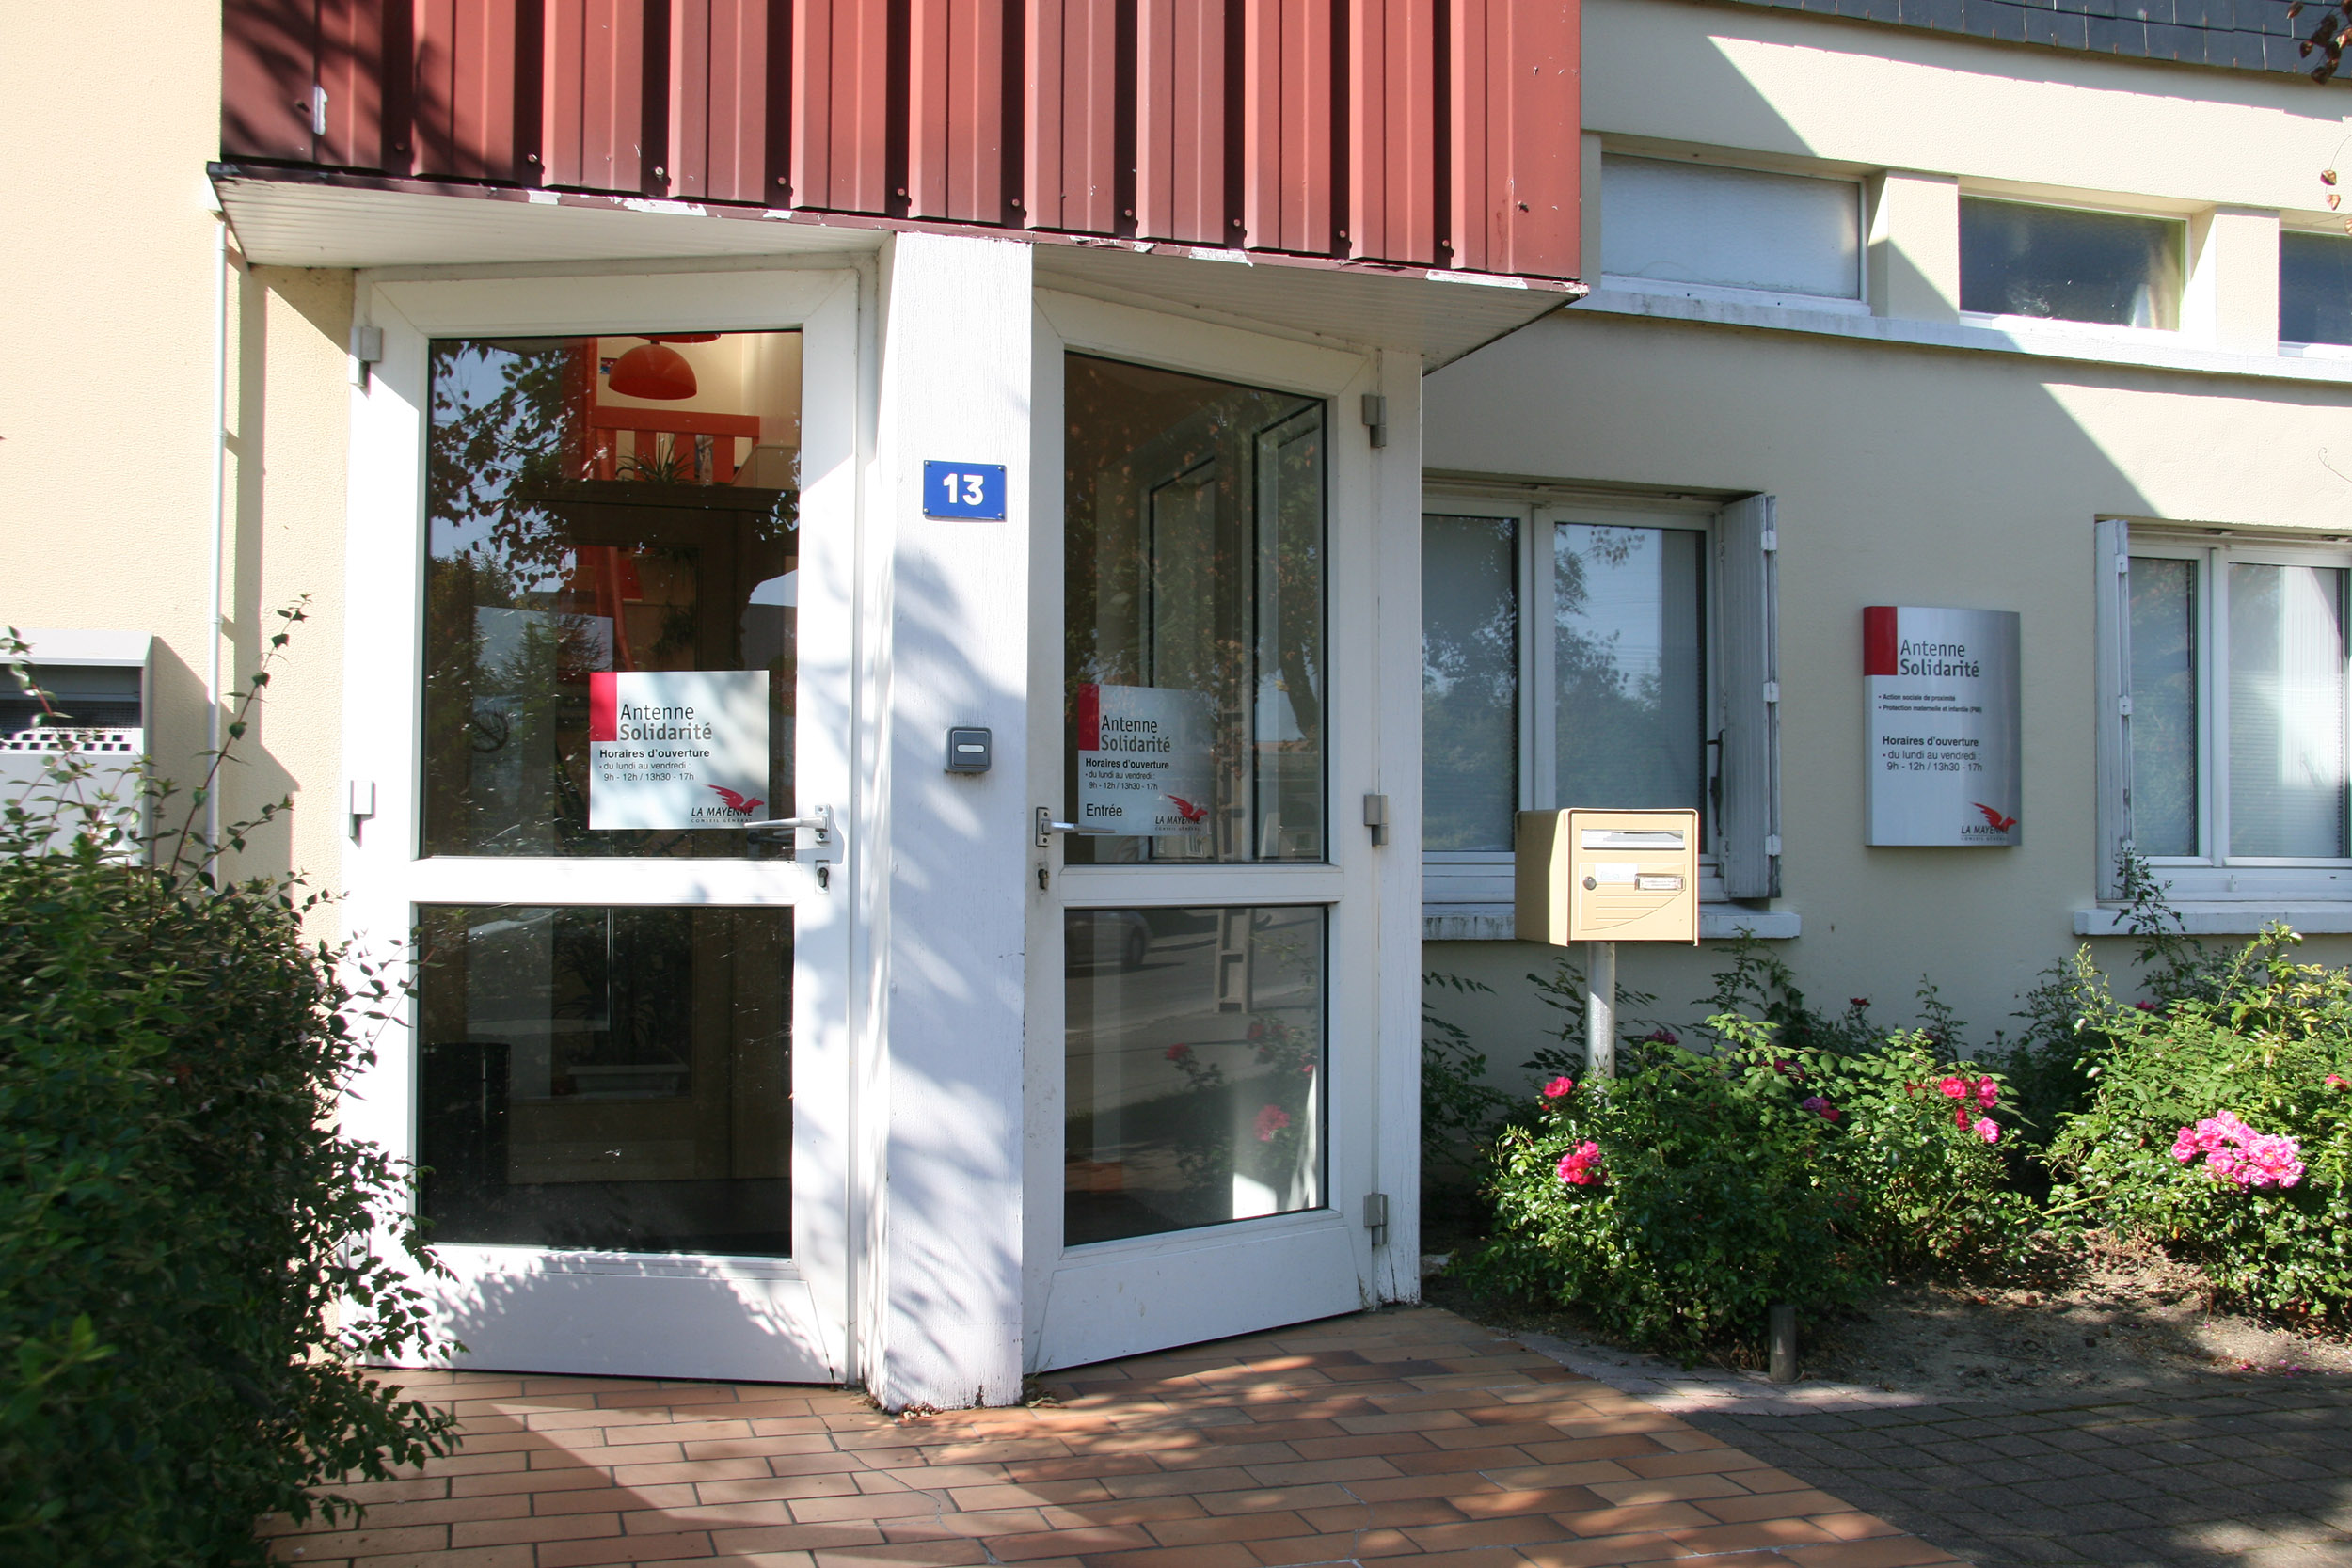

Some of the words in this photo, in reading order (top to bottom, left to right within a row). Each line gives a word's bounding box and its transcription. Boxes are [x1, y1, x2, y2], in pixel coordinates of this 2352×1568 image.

[943, 473, 984, 505] 13
[1900, 640, 1965, 657] Antenne
[1900, 659, 1979, 677] Solidarité
[620, 704, 694, 720] Antenne
[1101, 715, 1157, 733] Antenne
[620, 722, 712, 740] Solidarité
[1101, 735, 1170, 752] Solidarité
[1883, 736, 1924, 745] Horaires
[1927, 736, 1979, 746] d'ouverture
[600, 749, 644, 758] Horaires
[648, 749, 709, 758] d'ouverture
[1888, 751, 1899, 759] du
[1902, 751, 1924, 759] lundi
[1941, 752, 1976, 760] vendredi
[1086, 758, 1120, 768] Horaires
[1123, 760, 1169, 768] d'ouverture
[1887, 762, 1899, 770] 9h
[1909, 762, 1925, 770] 12h
[1934, 763, 1959, 771] 13h30
[1968, 763, 1982, 771] 17h
[691, 807, 703, 816] LA
[707, 807, 753, 816] MAYENNE
[1086, 803, 1122, 816] Entrée
[1155, 816, 1164, 824] LA
